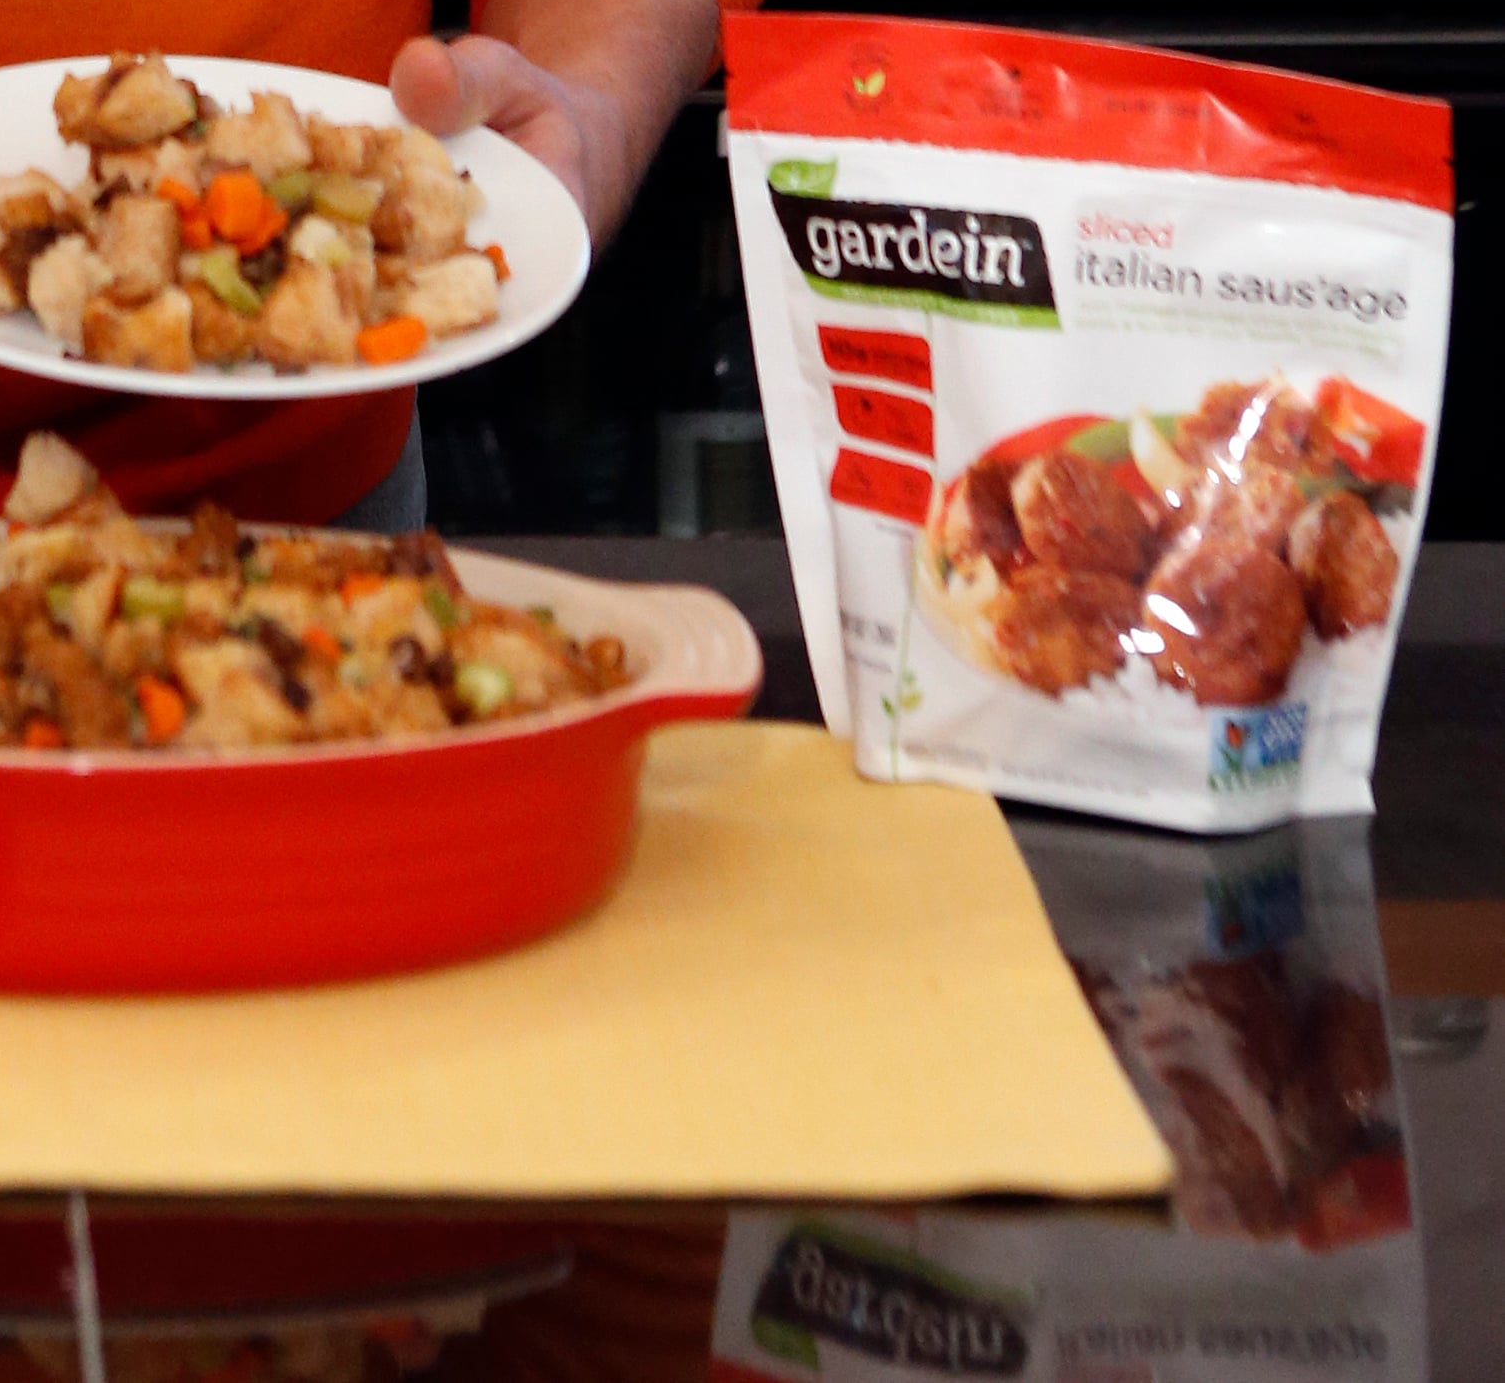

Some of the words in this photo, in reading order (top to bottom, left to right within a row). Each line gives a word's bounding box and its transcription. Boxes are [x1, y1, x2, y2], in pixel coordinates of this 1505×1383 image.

[807, 212, 1026, 288] gardein
[1077, 213, 1175, 249] sliced
[1074, 247, 1203, 299] italian
[1217, 272, 1408, 322] saus'age
